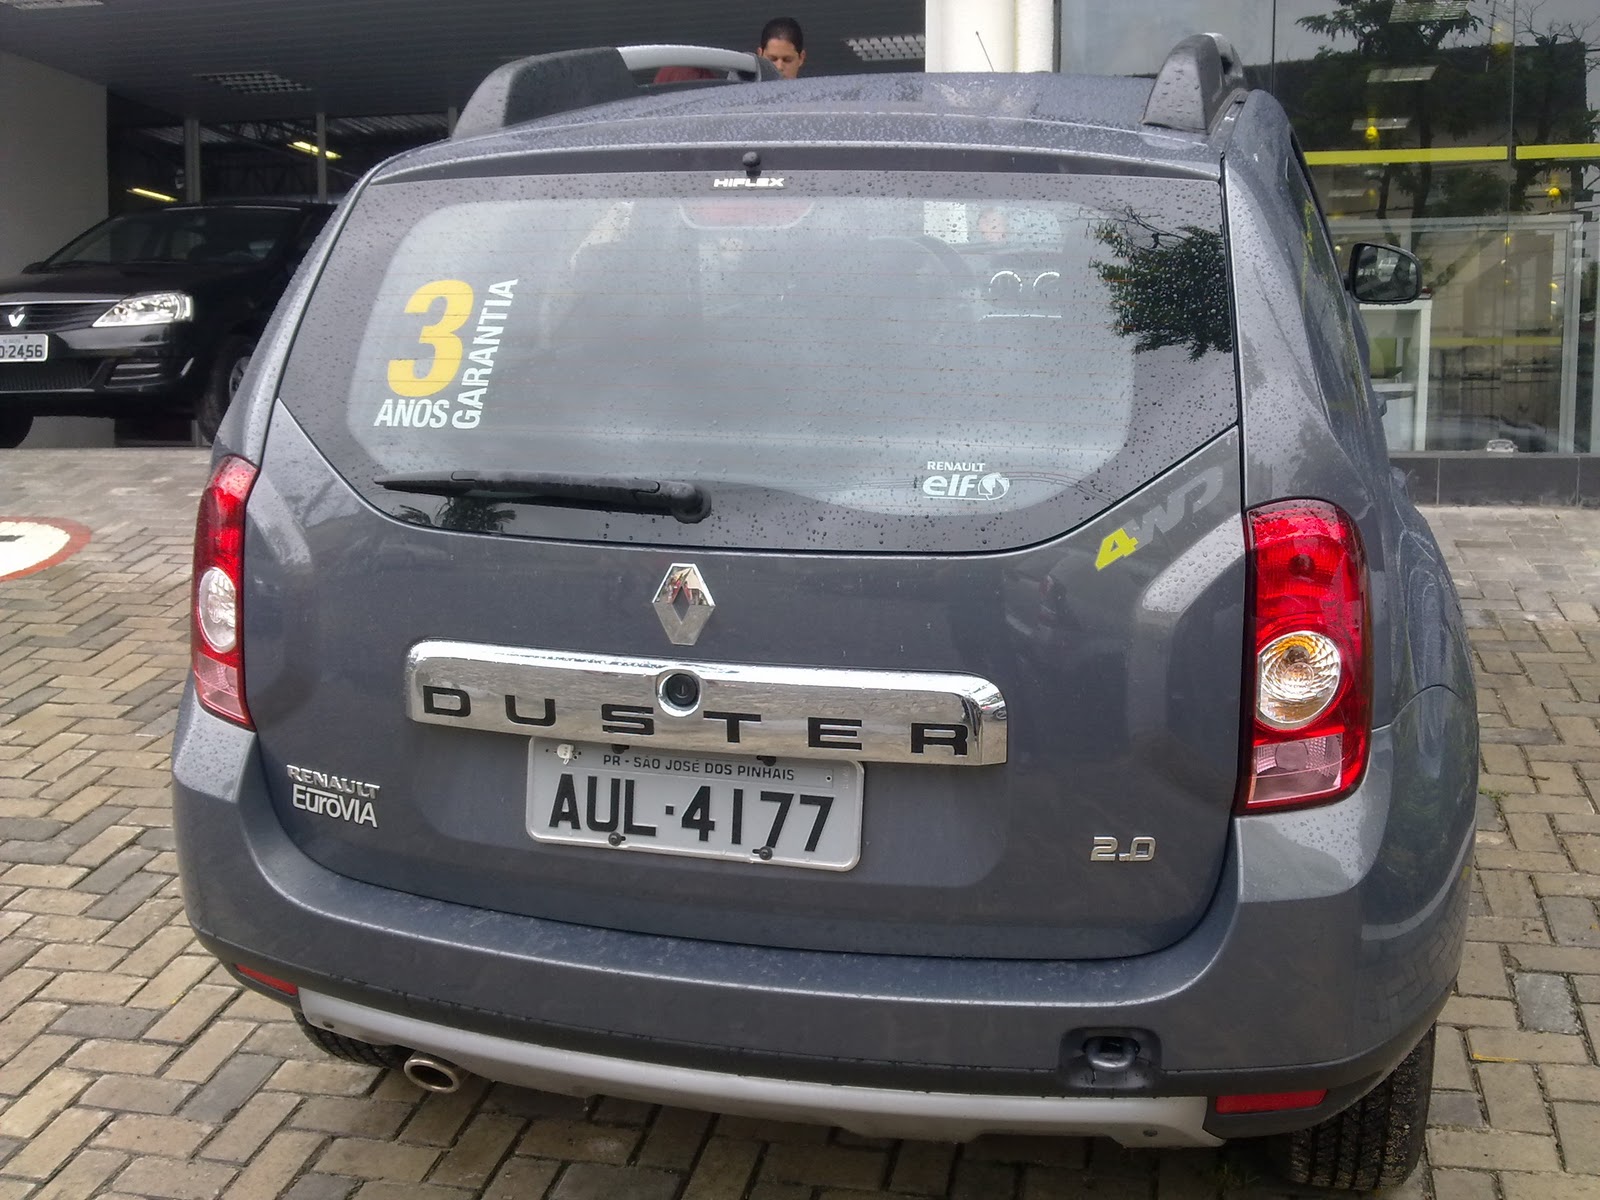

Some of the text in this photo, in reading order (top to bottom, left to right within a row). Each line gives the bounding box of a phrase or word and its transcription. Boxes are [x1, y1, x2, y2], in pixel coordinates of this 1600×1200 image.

[713, 177, 785, 188] HIFLEX
[387, 279, 474, 398] 3
[451, 278, 519, 430] GARANTIA
[373, 398, 450, 429] ANOS
[927, 461, 986, 472] RENAULT
[922, 474, 978, 497] elf
[422, 685, 969, 756] DUSTER
[286, 764, 380, 800] RENAULT
[603, 754, 621, 767] PR
[665, 758, 700, 773] JOSÉ
[704, 762, 733, 775] DOS
[737, 765, 795, 781] PINHAIS
[1090, 836, 1156, 862] 2.0
